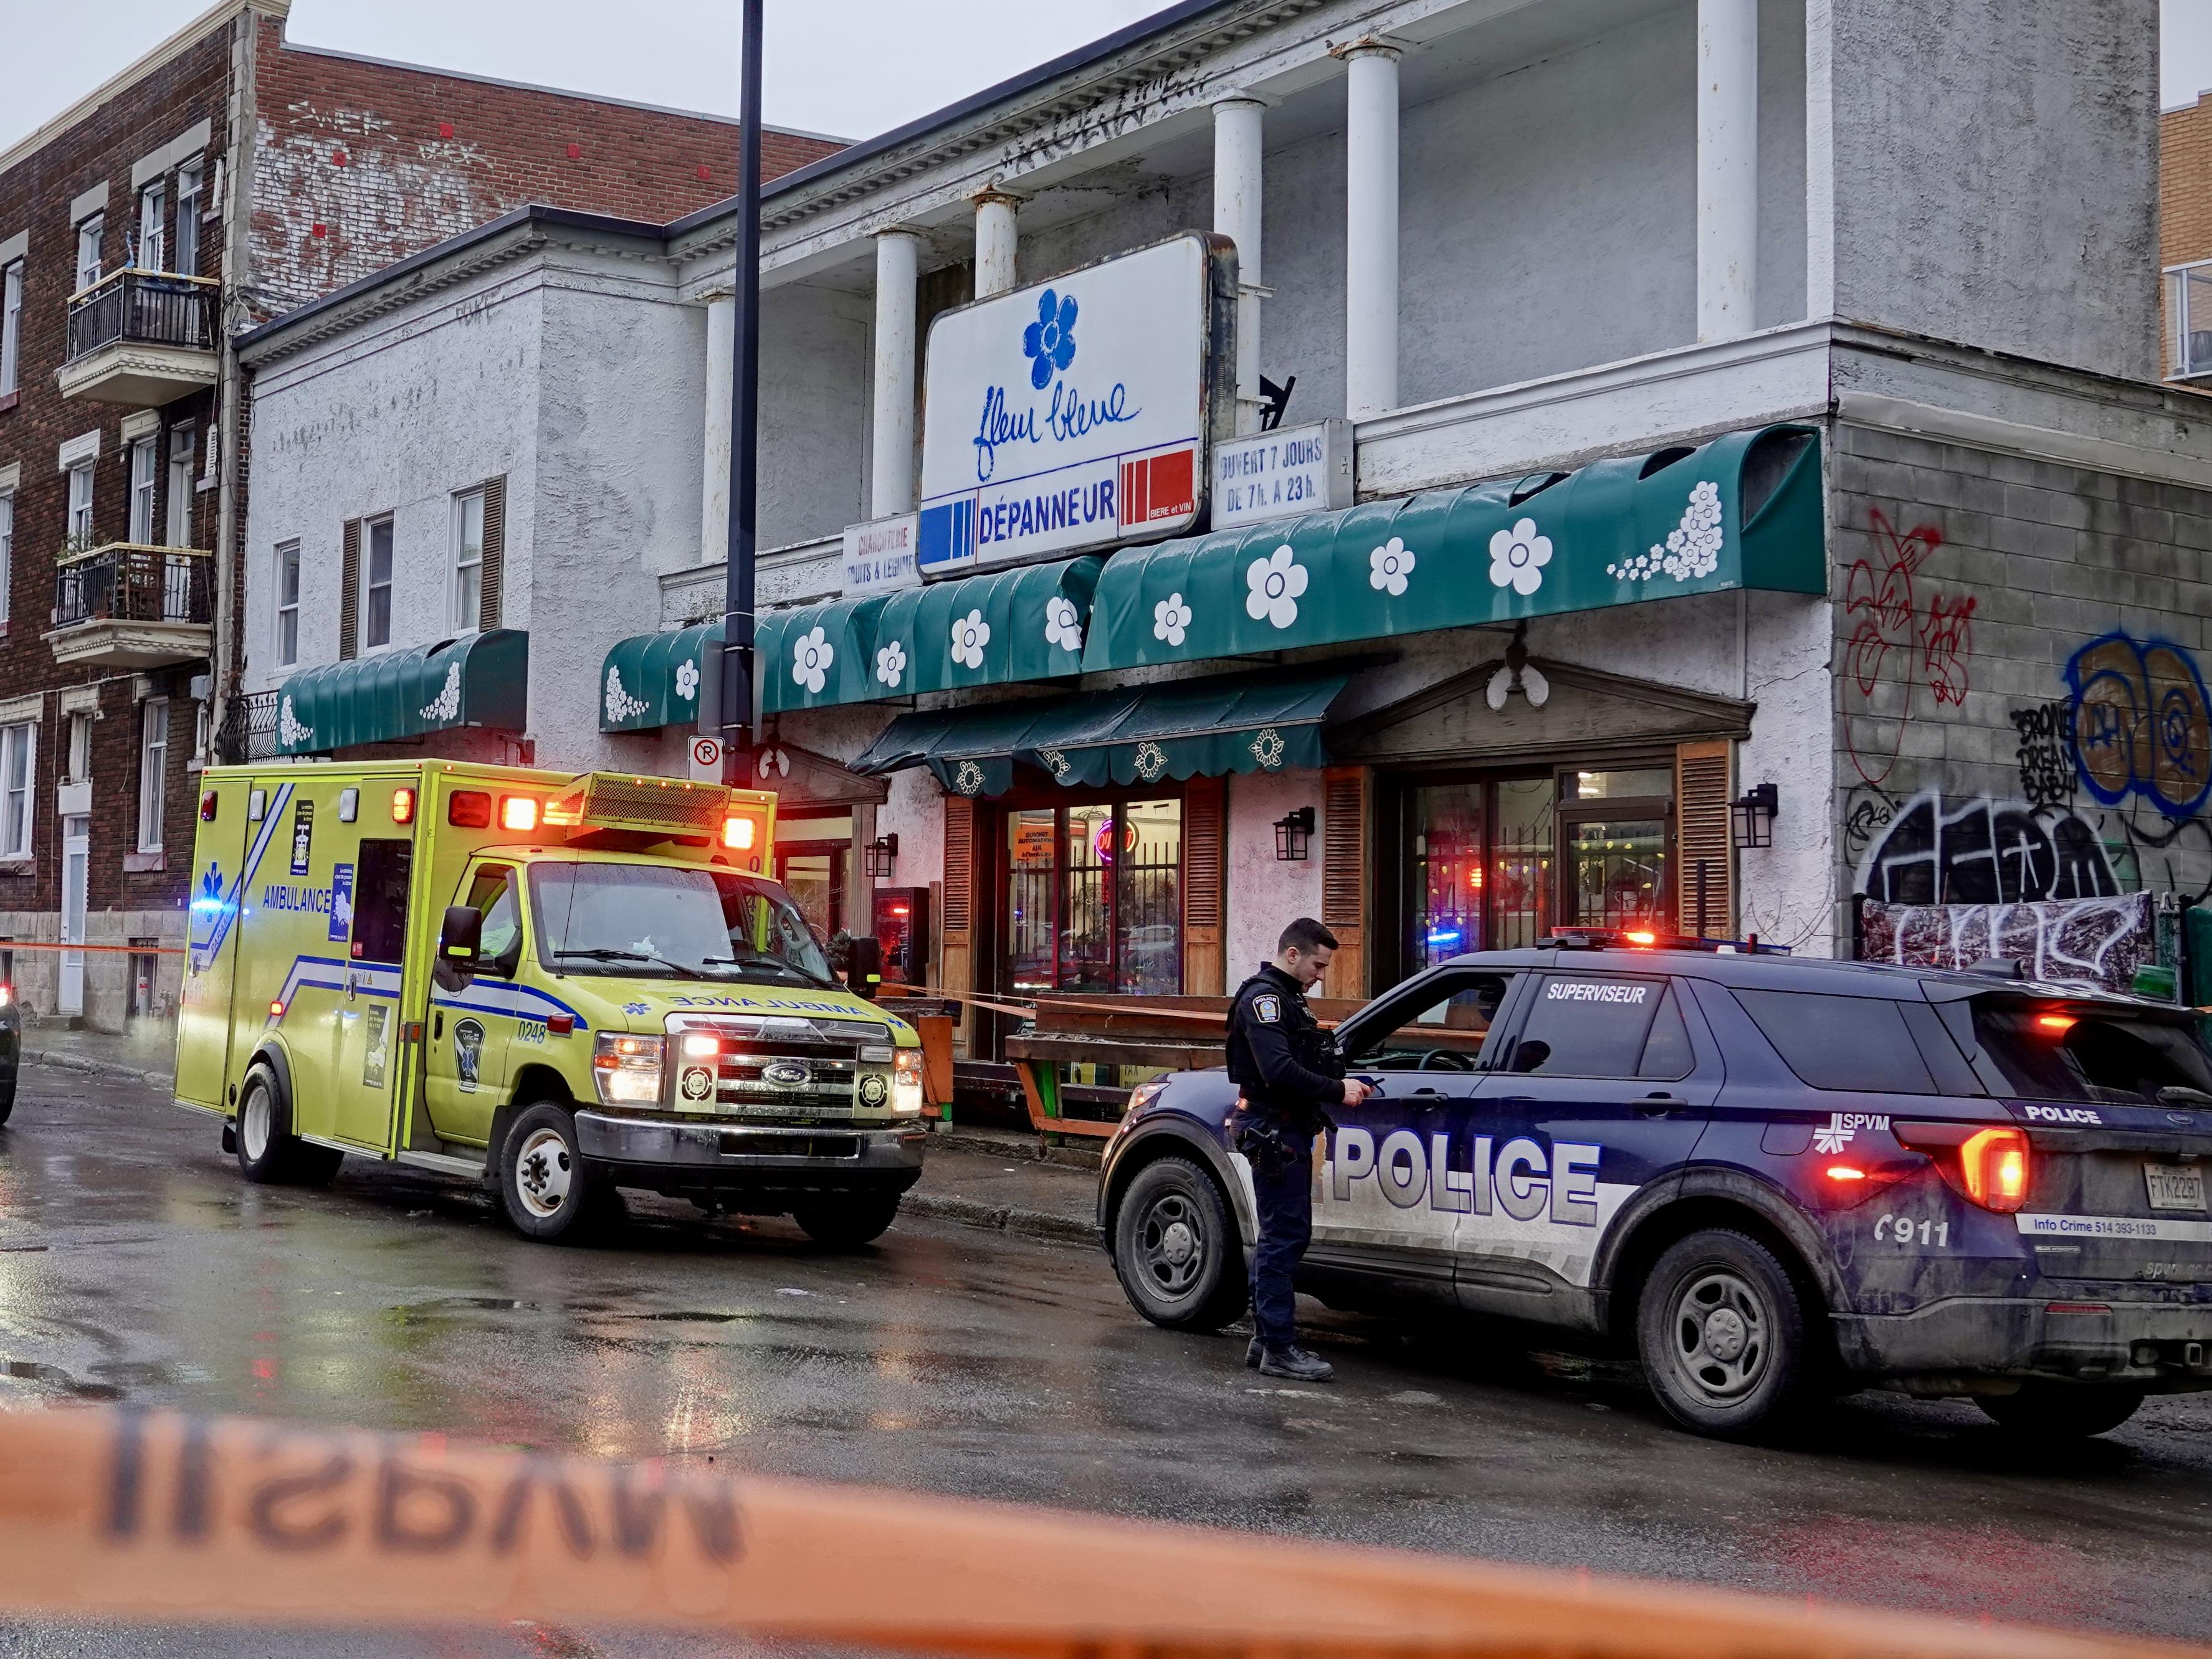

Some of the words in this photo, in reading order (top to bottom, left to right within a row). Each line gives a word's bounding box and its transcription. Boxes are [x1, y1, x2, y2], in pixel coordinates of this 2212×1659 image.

[973, 385, 1043, 482] fleur
[1045, 379, 1142, 441] bleue
[1220, 449, 1266, 480] OUVERT
[1270, 445, 1277, 470] 7
[1282, 437, 1322, 468] JOURS
[1228, 488, 1242, 512] DE
[1274, 480, 1281, 503] A
[979, 479, 1115, 544] DÉPANNEUR
[1150, 506, 1170, 518] BIERE
[1171, 505, 1178, 513] et
[1179, 502, 1191, 512] VIN
[847, 562, 871, 585] FRUITS
[875, 561, 880, 579] &
[262, 885, 331, 914] AMBULANCE
[1547, 983, 1646, 1004] SUPERVISEUR
[518, 1020, 546, 1044] 0248
[779, 1069, 801, 1080] Ford
[1843, 1113, 1890, 1131] SPVM
[2024, 1106, 2103, 1124] POLICE
[1333, 1124, 1602, 1227] POLICE
[1894, 1217, 1948, 1246] 911
[2034, 1219, 2056, 1230] Info
[2060, 1219, 2092, 1232] Crime
[2095, 1221, 2113, 1233] 514
[2115, 1222, 2157, 1235] 393-1133
